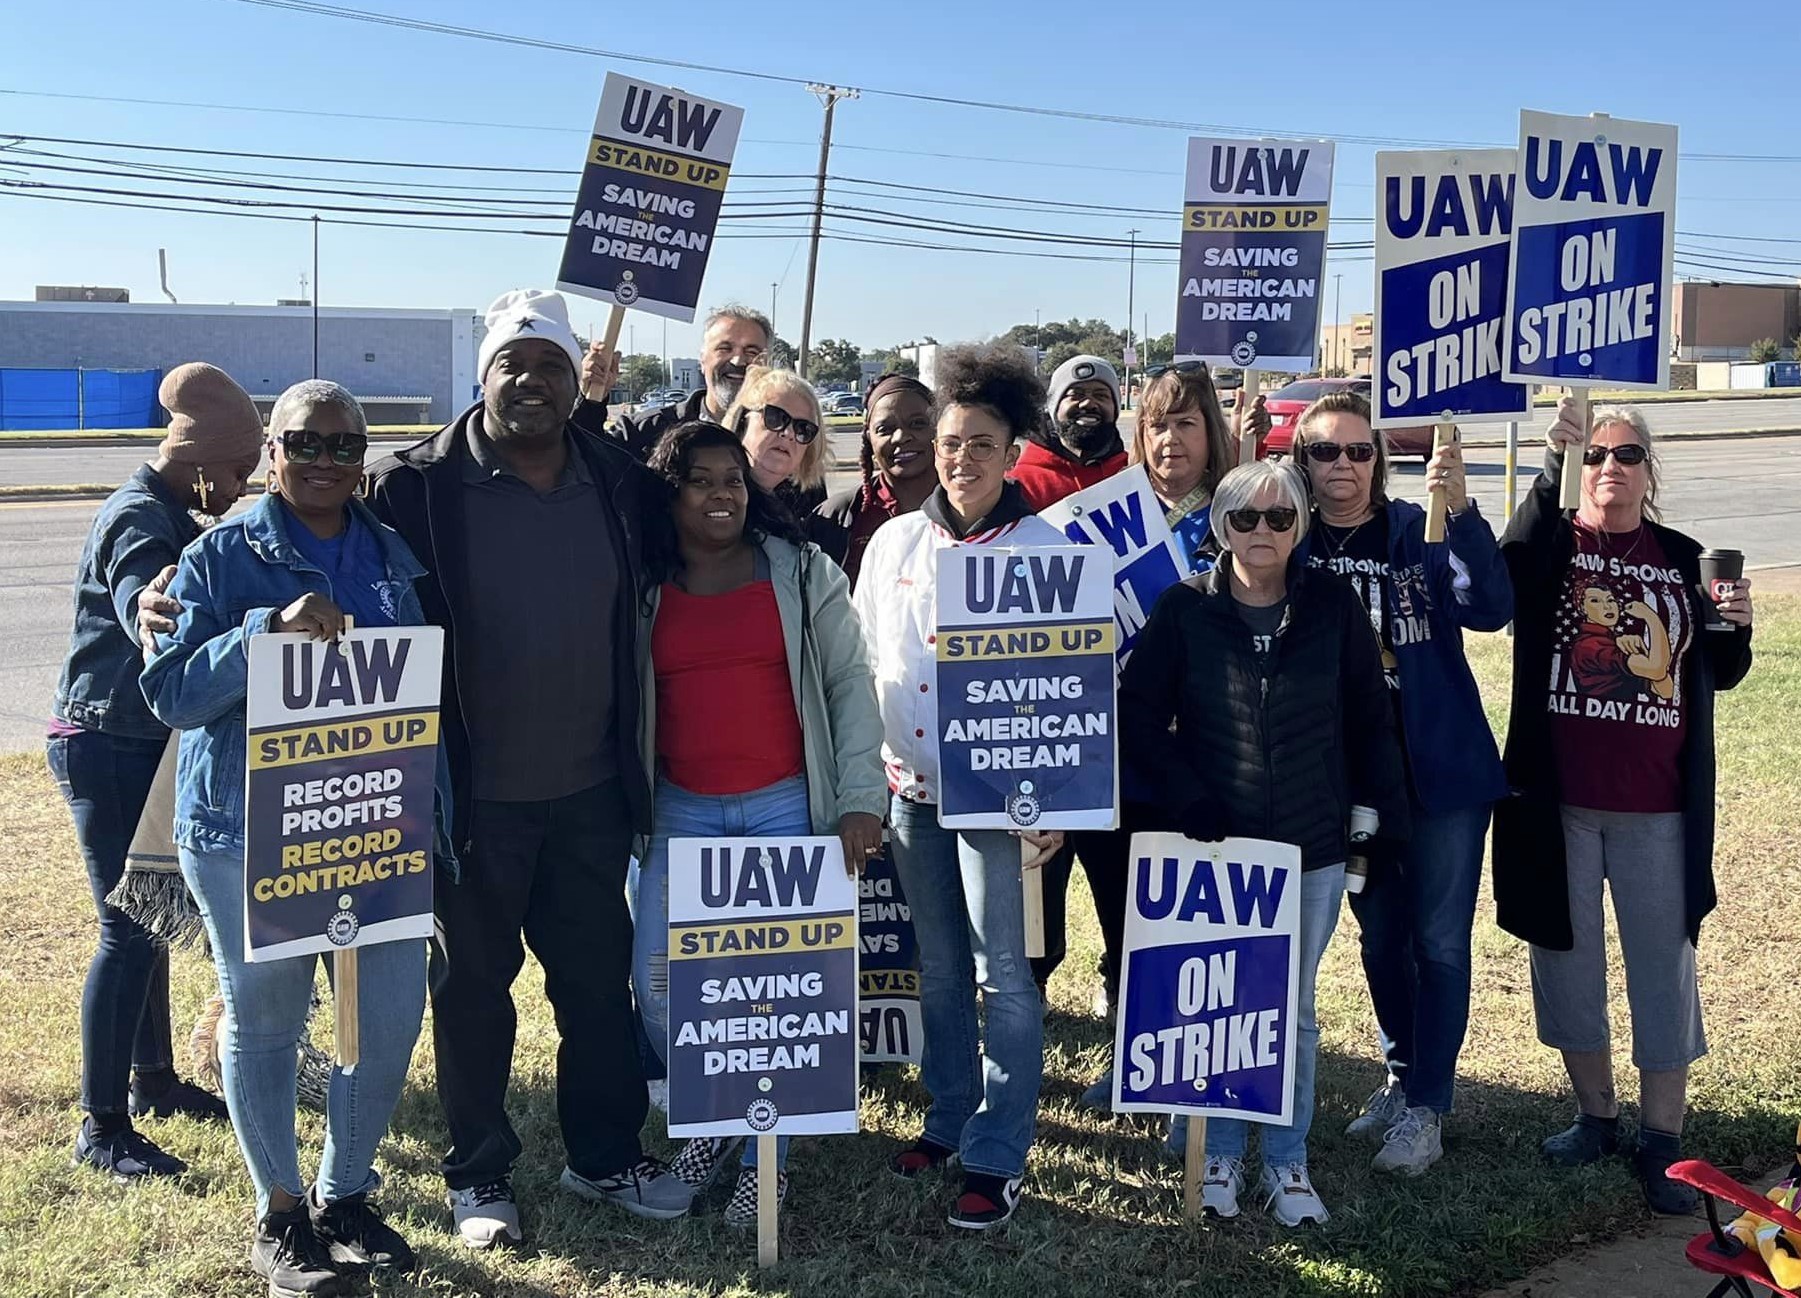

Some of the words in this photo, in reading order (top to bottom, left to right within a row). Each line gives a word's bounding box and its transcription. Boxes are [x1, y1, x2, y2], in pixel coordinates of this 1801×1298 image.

[621, 85, 722, 152] UAW
[595, 145, 679, 176] STAND
[687, 164, 719, 184] UP
[1210, 145, 1310, 196] UAW
[1524, 136, 1663, 207] UAW
[602, 183, 696, 218] SAVING
[637, 211, 654, 222] THE
[1385, 173, 1516, 239] UAW
[575, 209, 708, 251] AMERICAN
[1191, 211, 1276, 228] STAND
[1285, 211, 1318, 228] UP
[591, 236, 681, 270] DREAM
[1204, 247, 1299, 267] SAVING
[1561, 228, 1616, 292] ON
[1182, 278, 1316, 298] AMERICAN
[1242, 269, 1259, 278] THE
[1202, 302, 1291, 321] DREAM
[1429, 259, 1480, 329] ON
[1518, 282, 1655, 364] STRIKE
[1386, 316, 1502, 407] STRIK
[1571, 553, 1605, 572] AW
[964, 555, 1085, 614] UAW
[946, 632, 1050, 657] STAND
[1061, 629, 1103, 651] UP
[282, 638, 412, 710] UAW
[966, 675, 1083, 704] SAVING
[1014, 704, 1035, 714] THE
[1547, 694, 1580, 715] ALL
[1586, 699, 1632, 721] DAY
[1635, 704, 1680, 728] LONG
[260, 726, 372, 763] STAND
[384, 719, 426, 744] UP
[943, 713, 1108, 744] AMERICAN
[971, 743, 1080, 771] DREAM
[284, 768, 403, 807] RECORD
[282, 795, 402, 836] PROFITS
[281, 828, 401, 869] RECORD
[253, 850, 426, 902] CONTRACTS
[700, 846, 826, 908] UAW
[859, 878, 893, 897] DR
[1135, 857, 1288, 929] UAW
[859, 903, 911, 923] AME
[680, 927, 790, 955] STAND
[801, 922, 844, 945] UP
[700, 972, 823, 1004] SAVING
[859, 973, 917, 992] STAN
[1177, 950, 1237, 1017] ON
[751, 1003, 773, 1014] THE
[675, 1010, 848, 1047] AMERICAN
[859, 1007, 910, 1056] UA
[704, 1044, 820, 1076] DREAM
[1129, 1009, 1280, 1092] STRIKE
